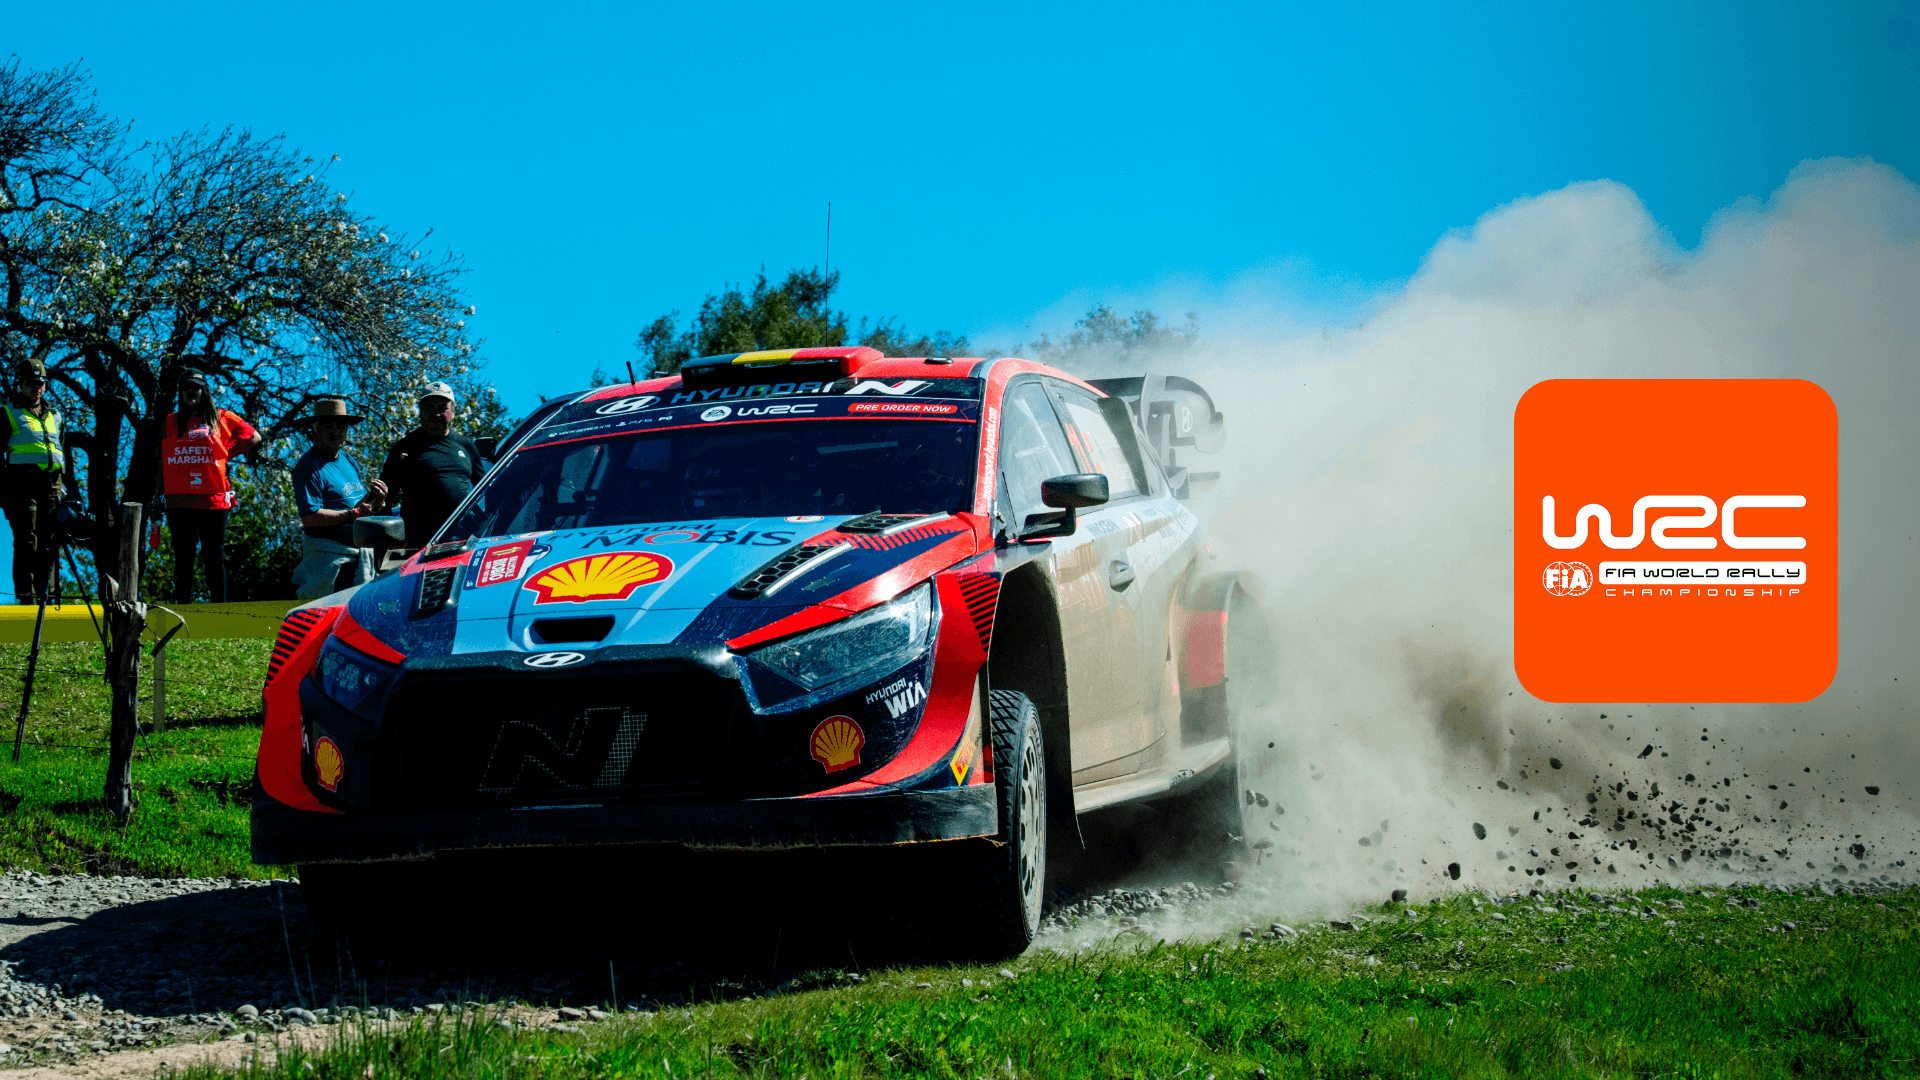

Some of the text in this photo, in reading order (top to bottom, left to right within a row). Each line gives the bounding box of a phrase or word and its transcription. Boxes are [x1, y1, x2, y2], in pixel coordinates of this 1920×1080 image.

[671, 381, 834, 404] HYUNDAI
[737, 403, 818, 416] WRC
[174, 446, 213, 455] SAFETY
[167, 455, 216, 465] MARSHAL
[578, 529, 796, 549] MOBIS
[865, 677, 907, 705] HYUNDAI
